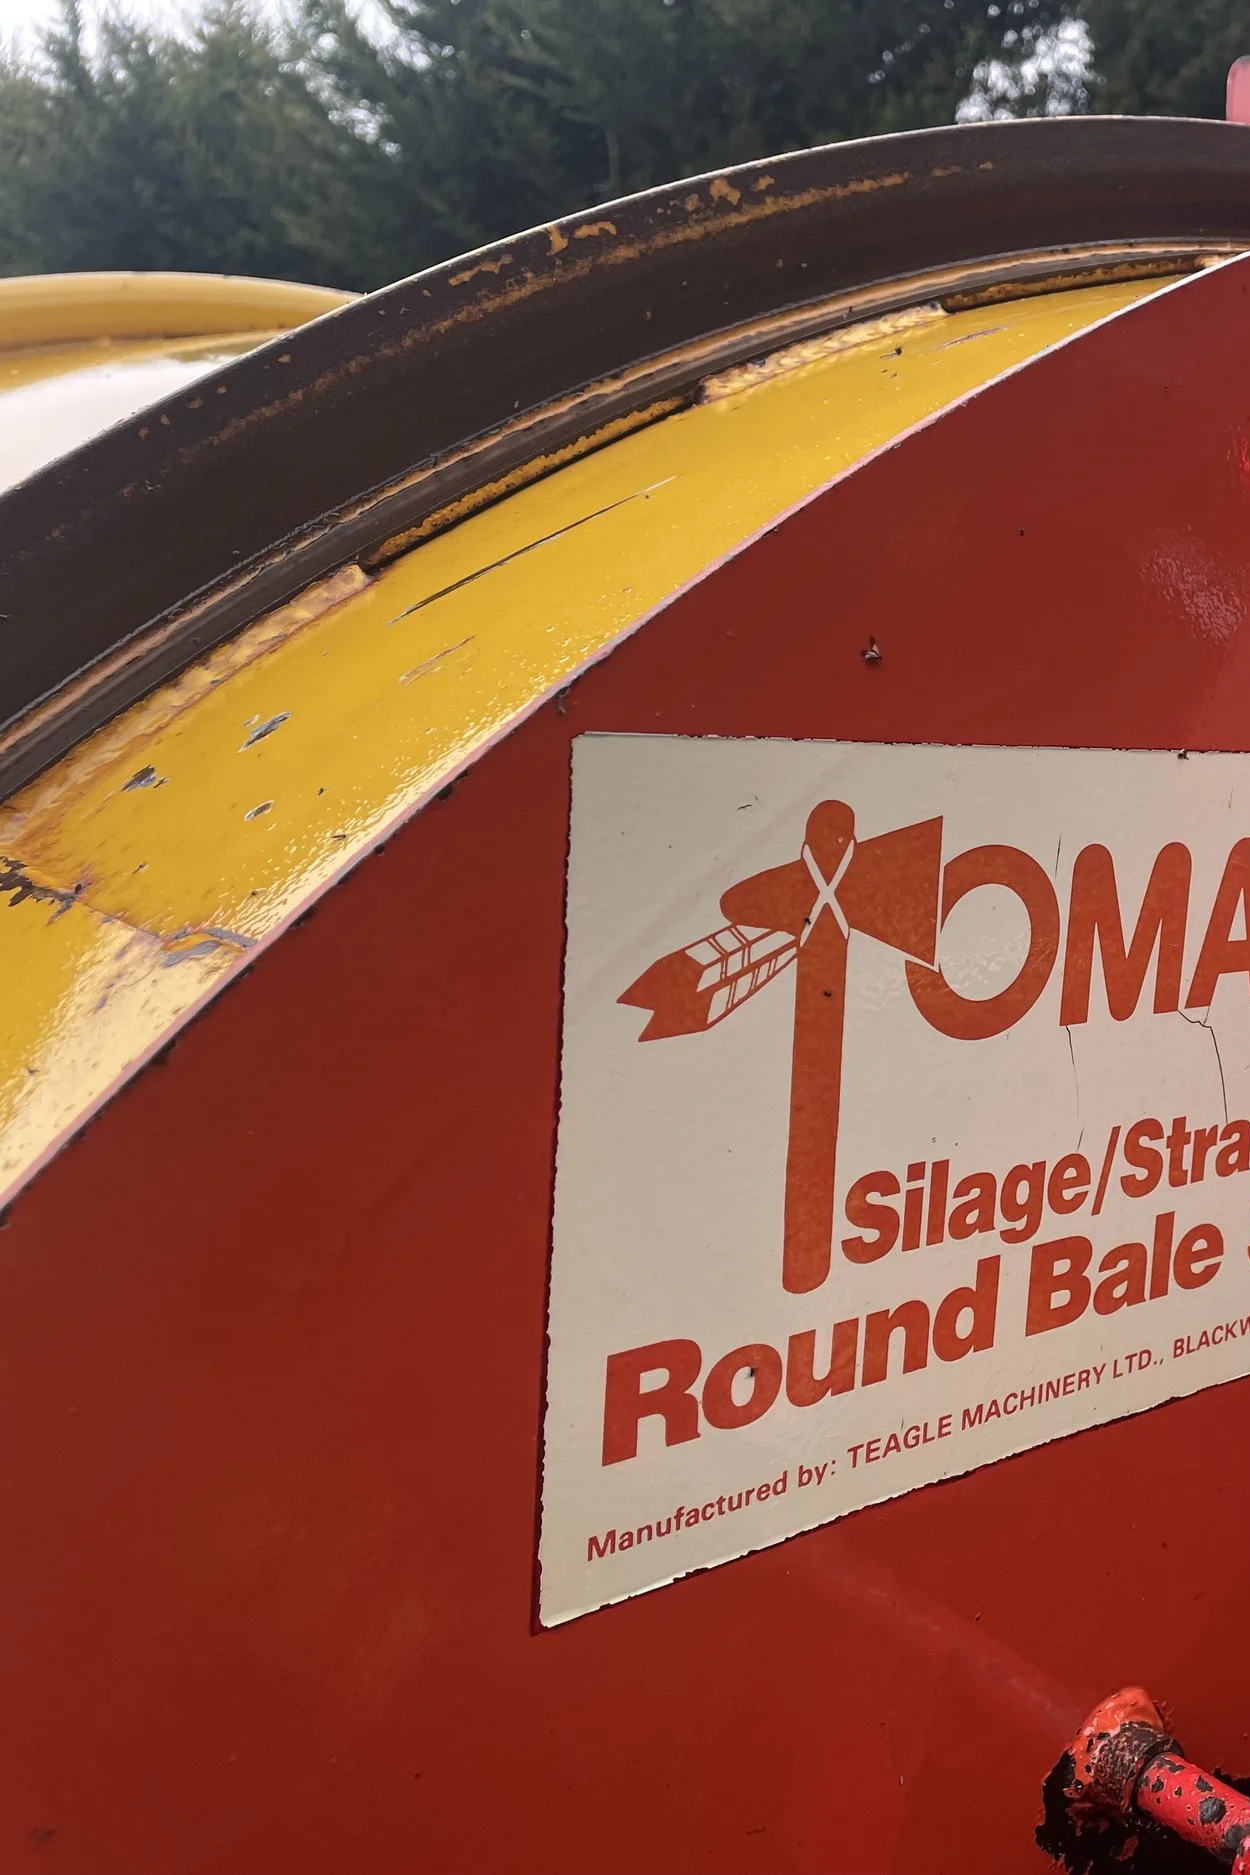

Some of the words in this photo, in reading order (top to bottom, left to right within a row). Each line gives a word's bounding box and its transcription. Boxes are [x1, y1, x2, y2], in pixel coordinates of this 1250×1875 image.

[586, 1470, 789, 1562] Manufactured
[796, 1459, 837, 1489] by:
[847, 1413, 953, 1469] TEAGLE
[960, 1362, 1107, 1431] MACHINERY
[1112, 1349, 1165, 1380] LTD.,
[601, 1254, 1002, 1467] Round
[1025, 1210, 1225, 1338] Bale
